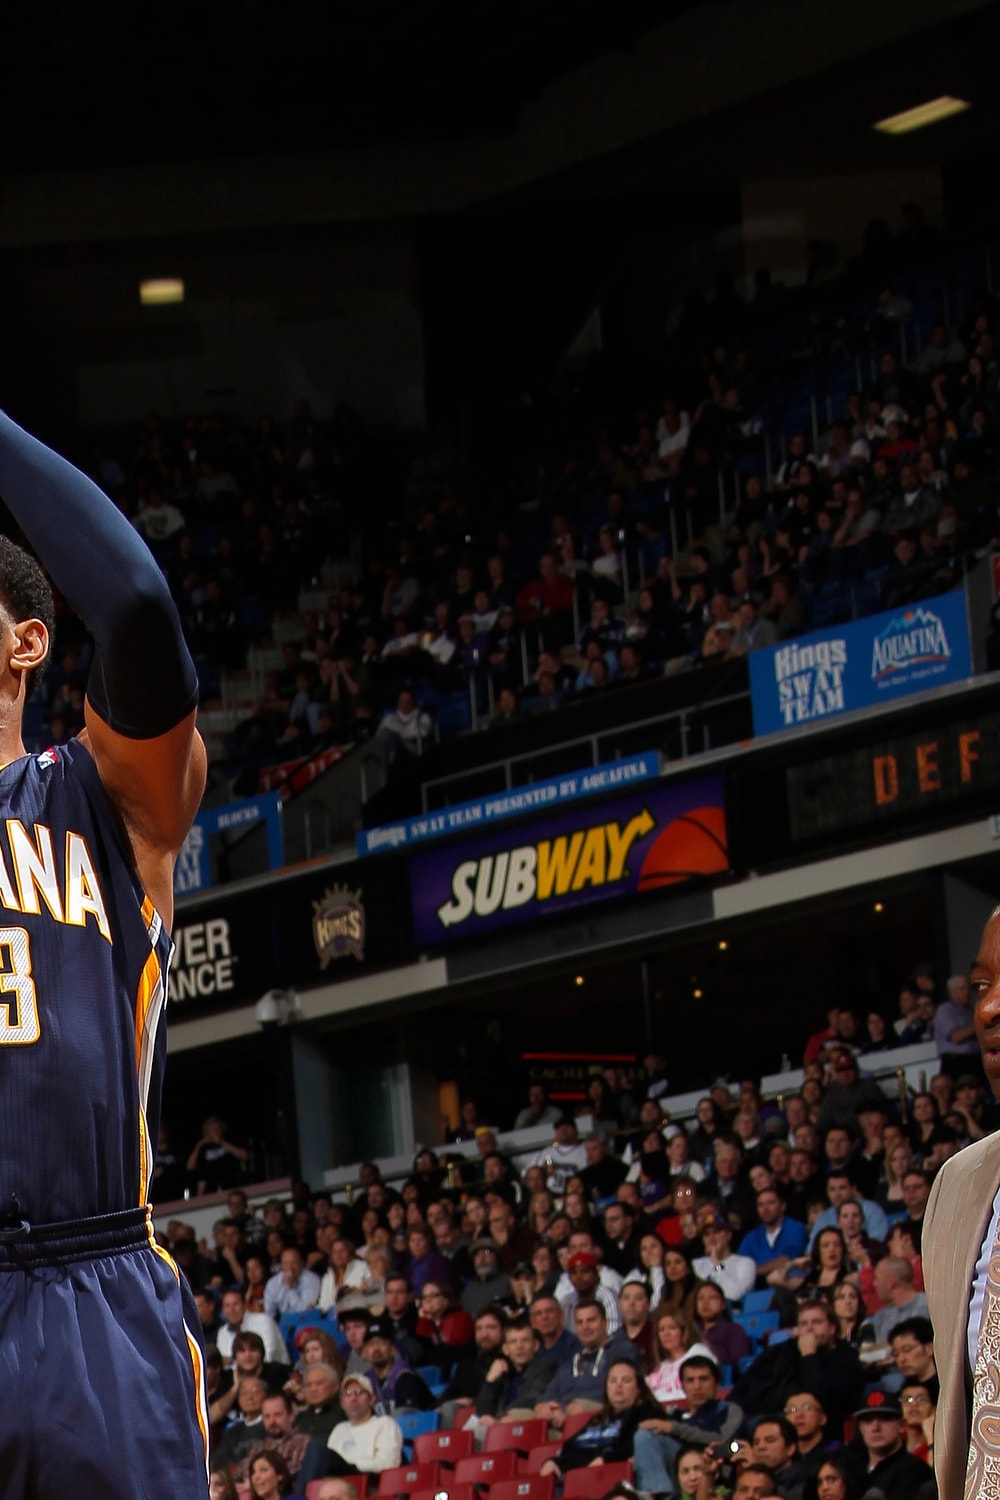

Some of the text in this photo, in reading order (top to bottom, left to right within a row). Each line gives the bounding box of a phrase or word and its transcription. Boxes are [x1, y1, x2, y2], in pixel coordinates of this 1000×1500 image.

[774, 639, 847, 683] Kings
[871, 618, 951, 680] AQUAFINA
[779, 665, 844, 701] SWAT
[780, 687, 844, 724] TEAM
[449, 803, 483, 827] TEAM
[485, 784, 558, 818] PRESENTED
[559, 778, 577, 797] BY
[580, 760, 648, 791] AQUAFINA
[437, 809, 656, 928] SUBWAY
[316, 909, 361, 949] KINGS
